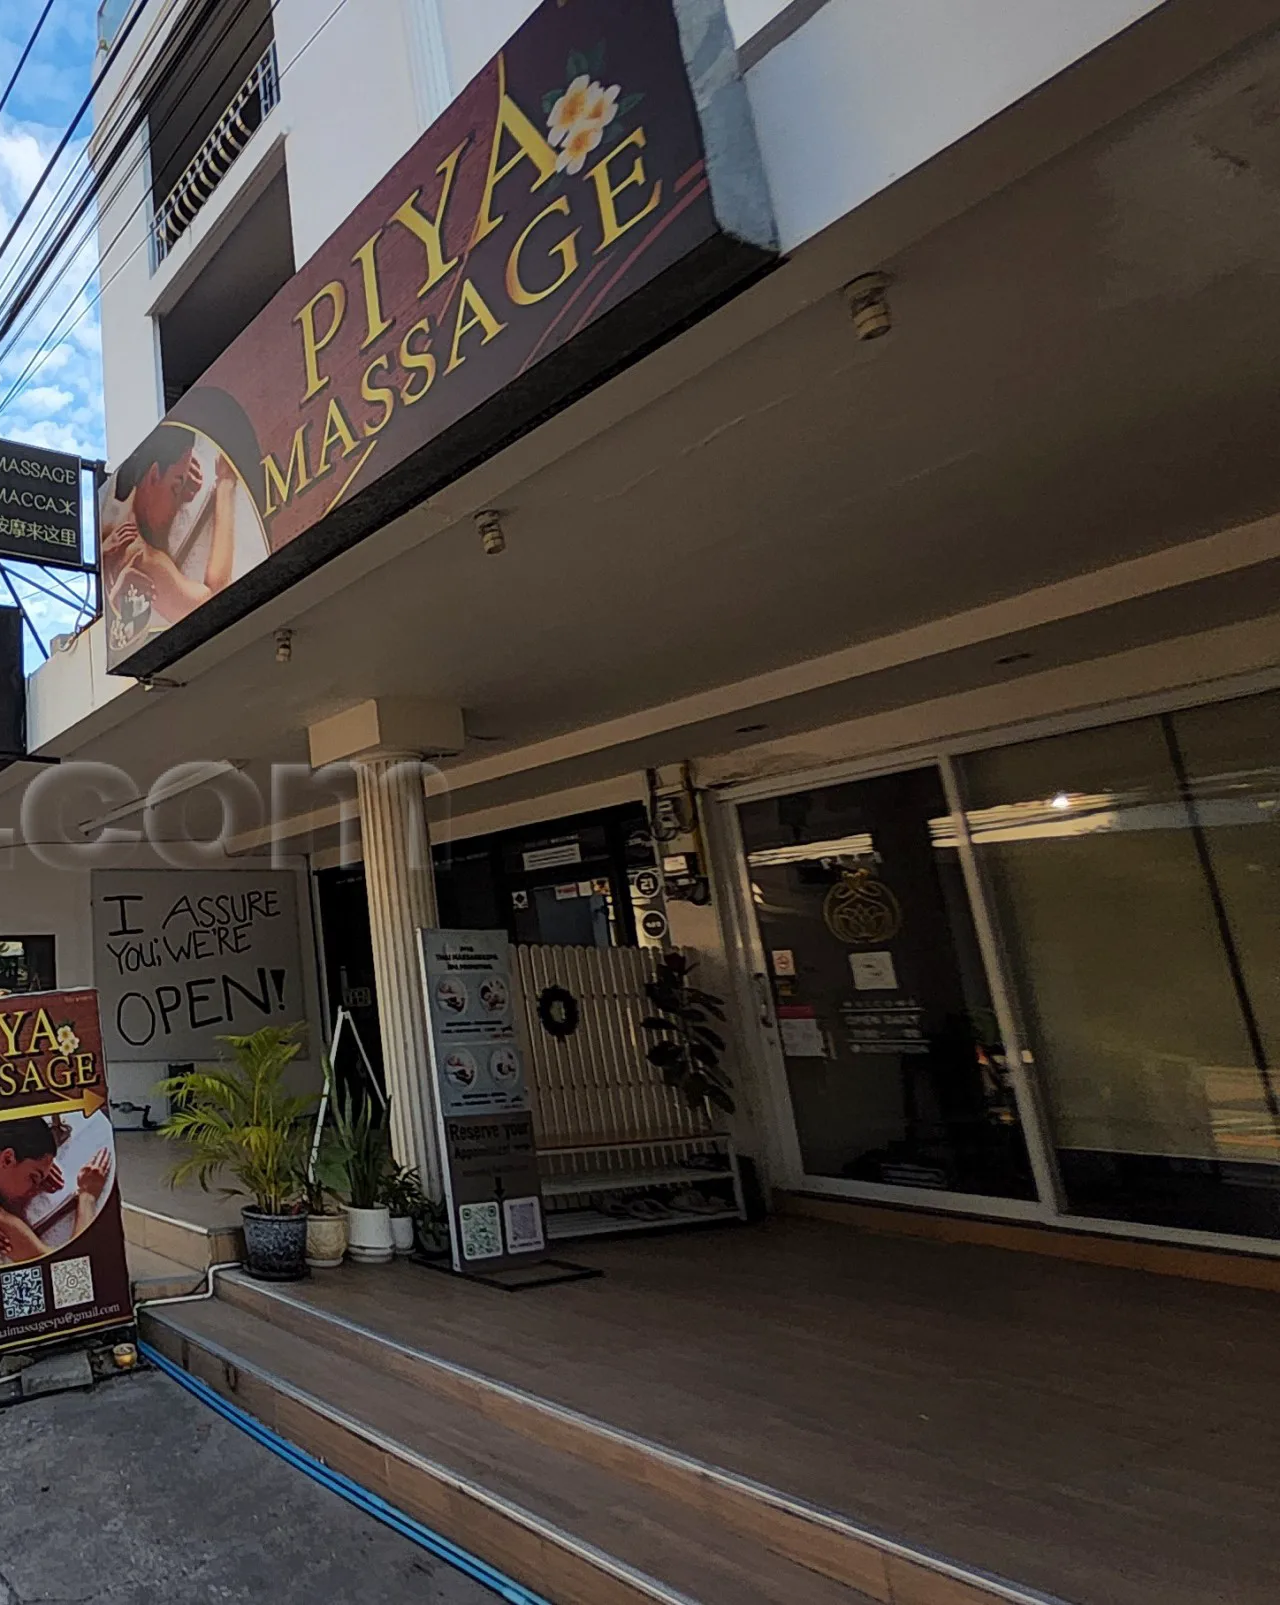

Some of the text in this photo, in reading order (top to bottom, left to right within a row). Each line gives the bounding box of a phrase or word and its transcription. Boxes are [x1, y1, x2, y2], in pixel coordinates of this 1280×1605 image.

[292, 92, 558, 408] PIYA
[260, 126, 662, 518] MASSAGE
[103, 890, 281, 937] I ASSURE
[116, 967, 287, 1047] OPEN!
[449, 1123, 499, 1141] Reserve
